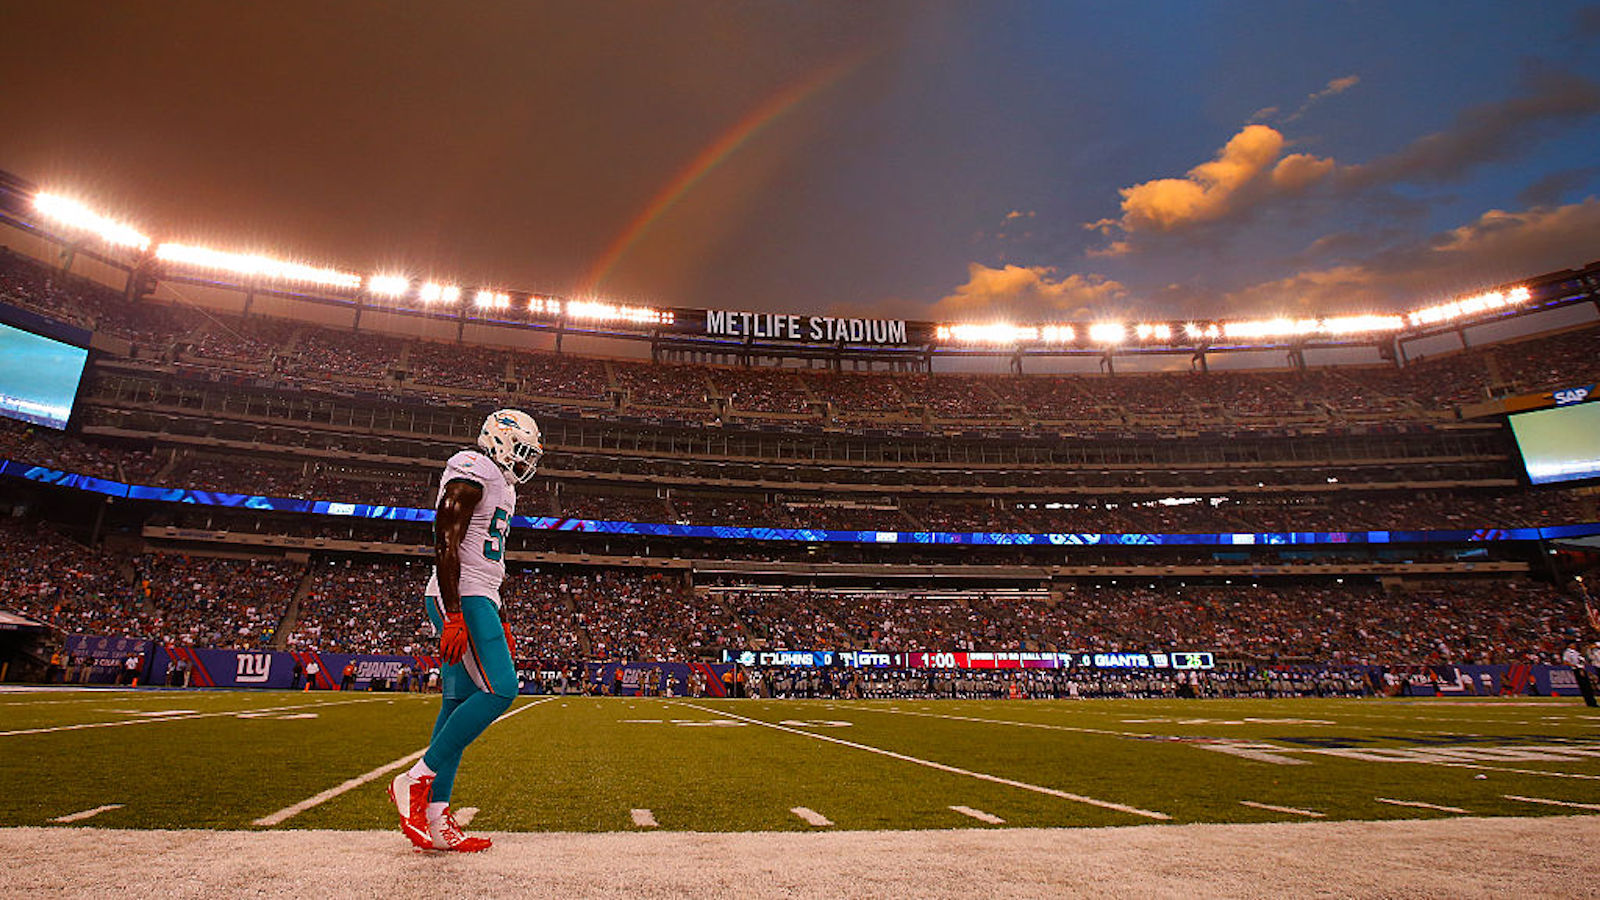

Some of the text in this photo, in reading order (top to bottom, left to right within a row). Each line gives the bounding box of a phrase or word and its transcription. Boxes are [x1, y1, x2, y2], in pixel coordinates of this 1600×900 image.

[706, 310, 908, 343] METLIFE STADIUM
[1554, 388, 1588, 405] SAP
[921, 652, 955, 668] 1:00
[1094, 653, 1149, 667] GIANTS
[1185, 655, 1202, 667] 25
[357, 661, 402, 678] GIANTS
